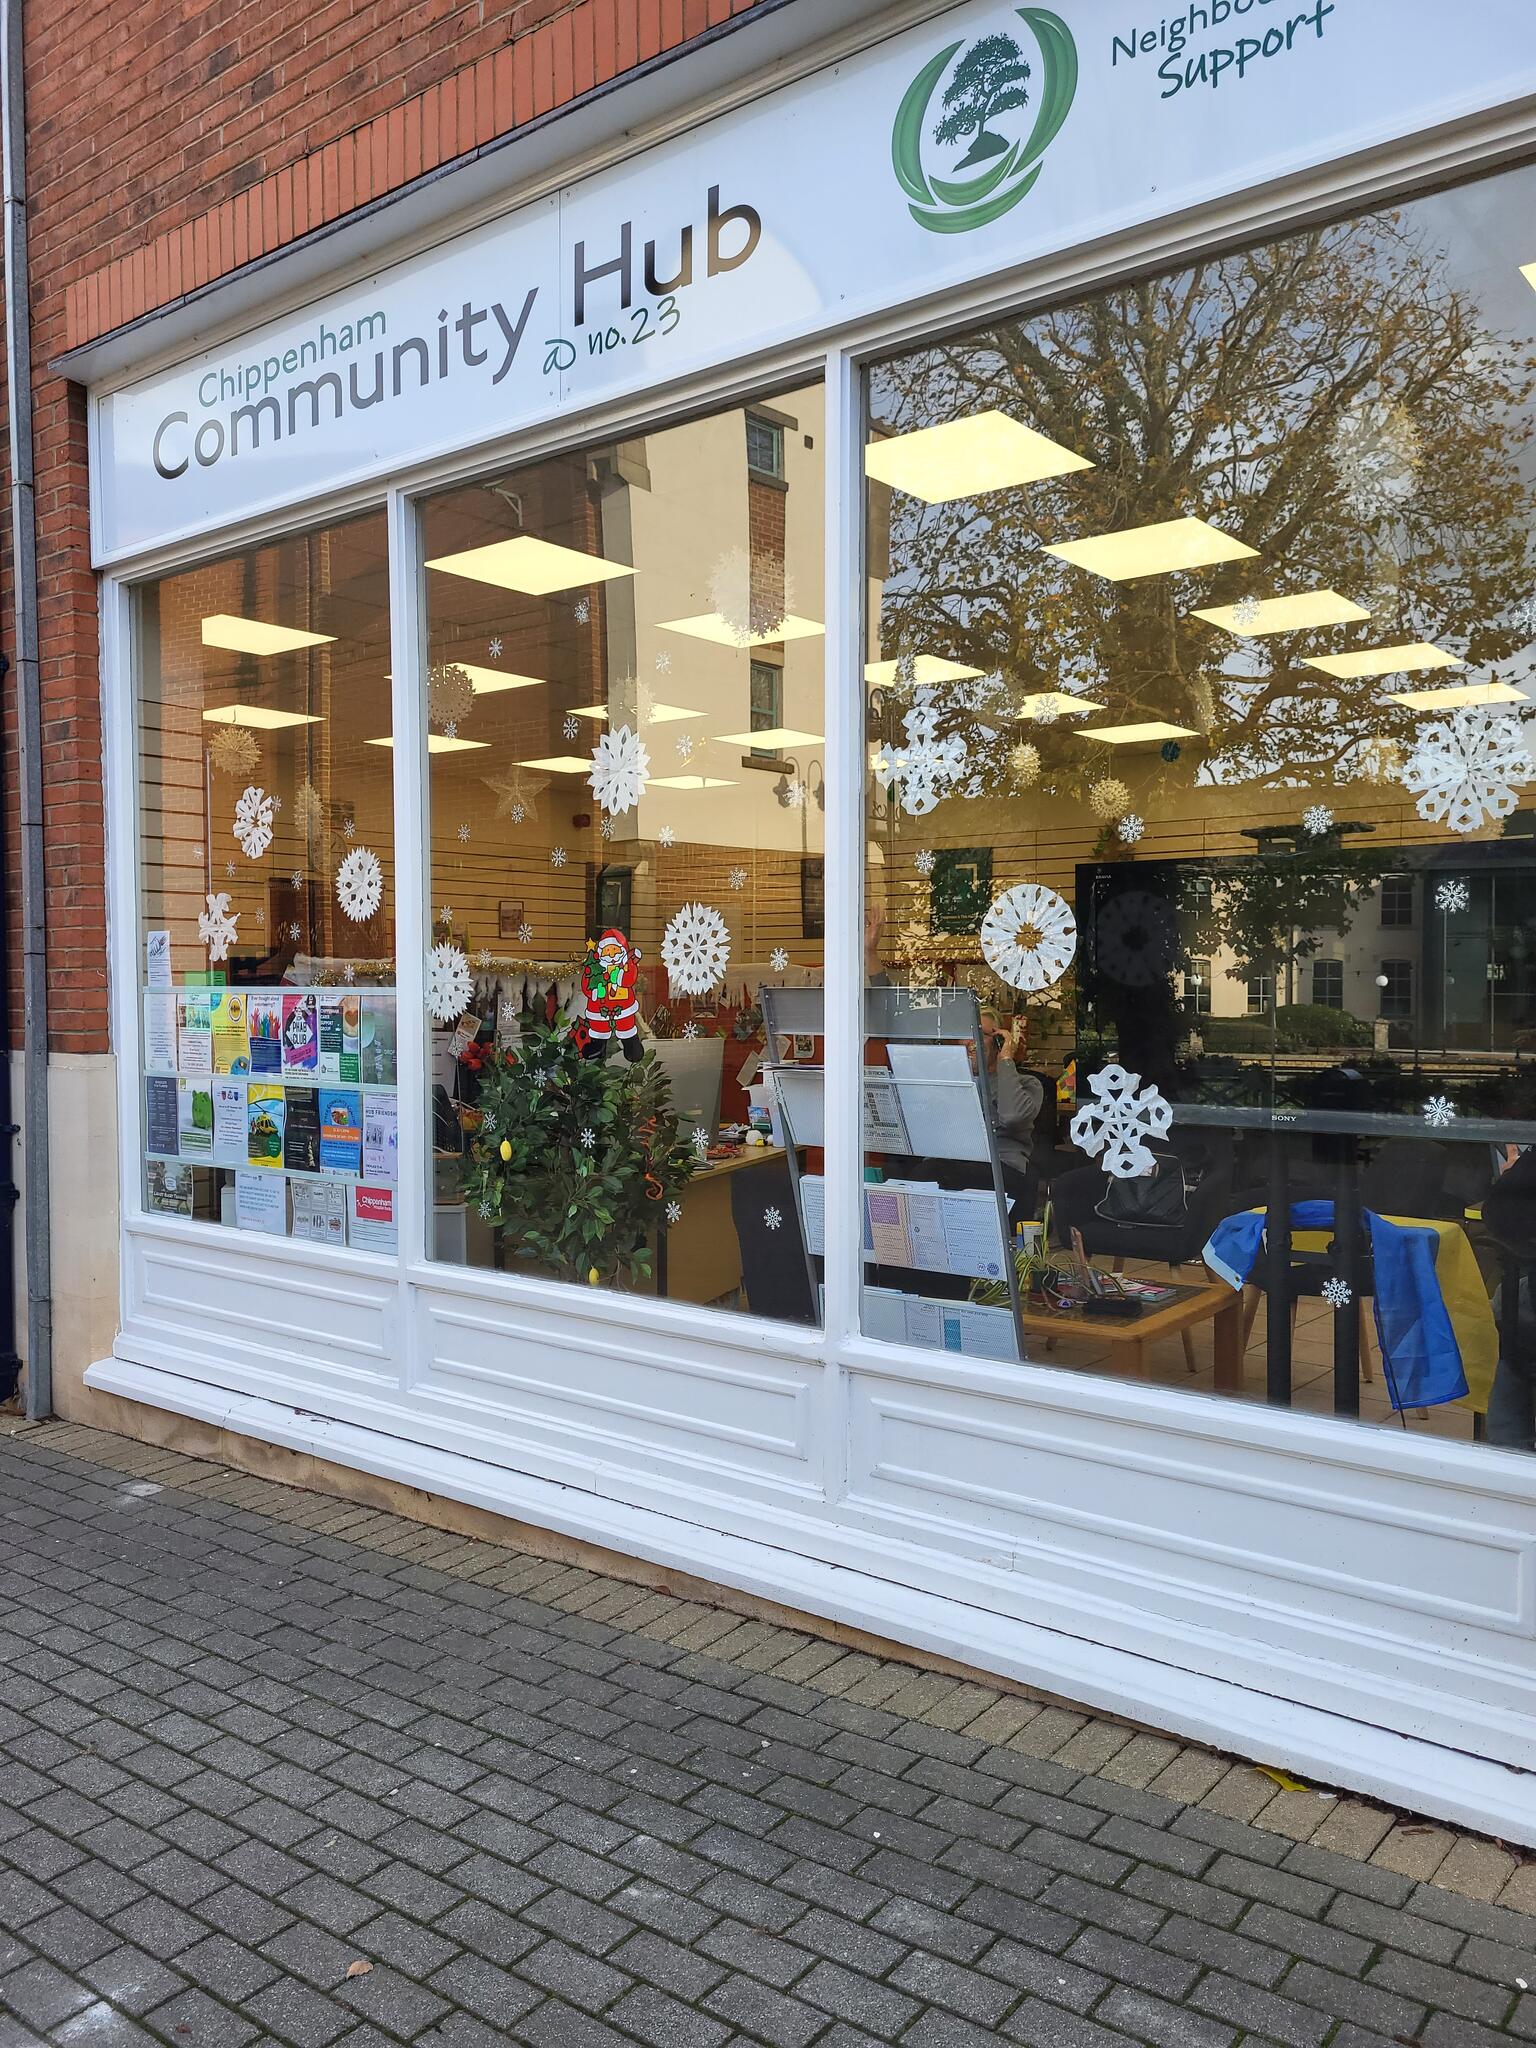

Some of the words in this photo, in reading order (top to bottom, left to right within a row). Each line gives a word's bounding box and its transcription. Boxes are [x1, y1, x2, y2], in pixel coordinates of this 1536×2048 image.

[1112, 0, 1276, 66] Neighbo
[1157, 0, 1335, 99] Support
[574, 184, 763, 326] Hub
[199, 309, 388, 408] Chippenham
[542, 339, 576, 376] @
[588, 296, 681, 356] no.23
[153, 286, 540, 480] Community
[292, 1021, 307, 1033] PHAB
[292, 1033, 307, 1045] CLUB
[361, 1196, 392, 1207] Chippenham
